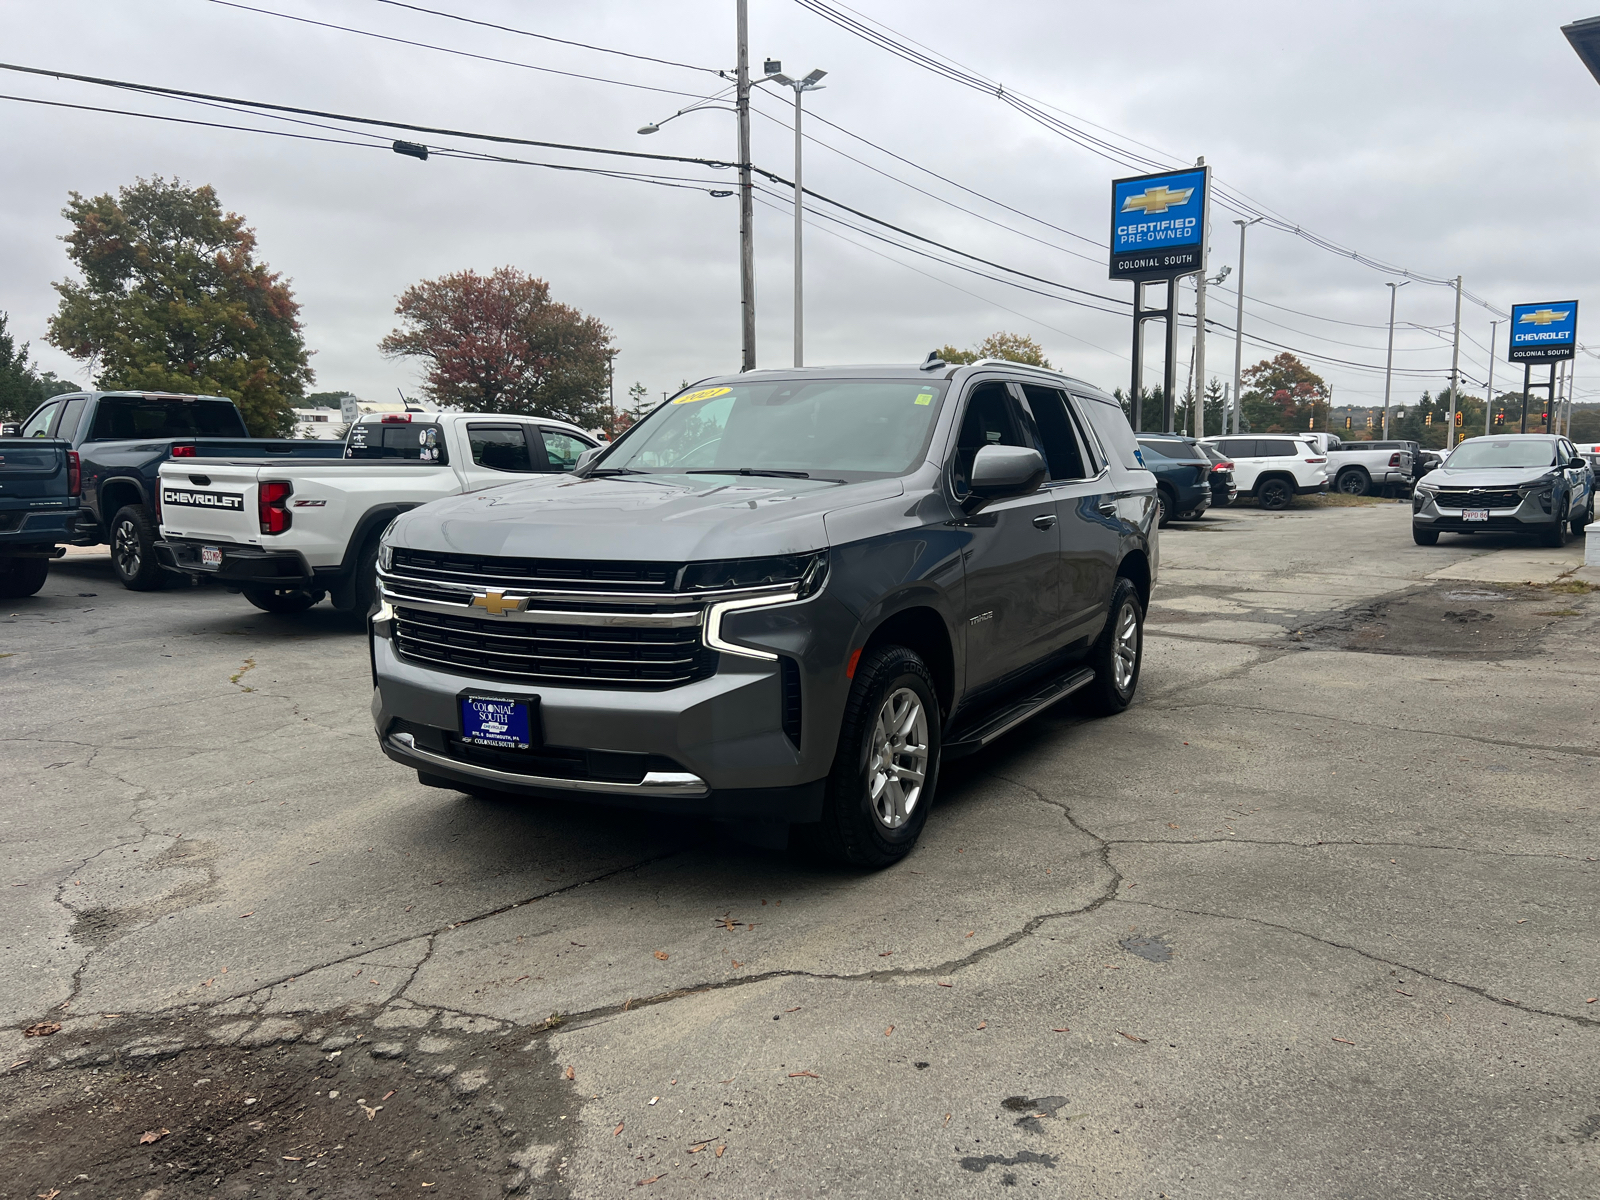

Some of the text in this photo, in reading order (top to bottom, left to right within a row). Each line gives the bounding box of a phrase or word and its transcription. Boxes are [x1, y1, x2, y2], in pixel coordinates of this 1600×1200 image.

[1117, 217, 1196, 235] CERTIFIED
[1120, 228, 1192, 244] PRE-OWNED
[1118, 254, 1193, 270] COLONIAL SOUTH
[1515, 331, 1571, 342] CHEVROLET
[1513, 350, 1545, 358] COLONIAL
[164, 491, 242, 508] CHEVROLET
[473, 702, 514, 714] COLONIAL
[479, 712, 507, 722] SOUTH
